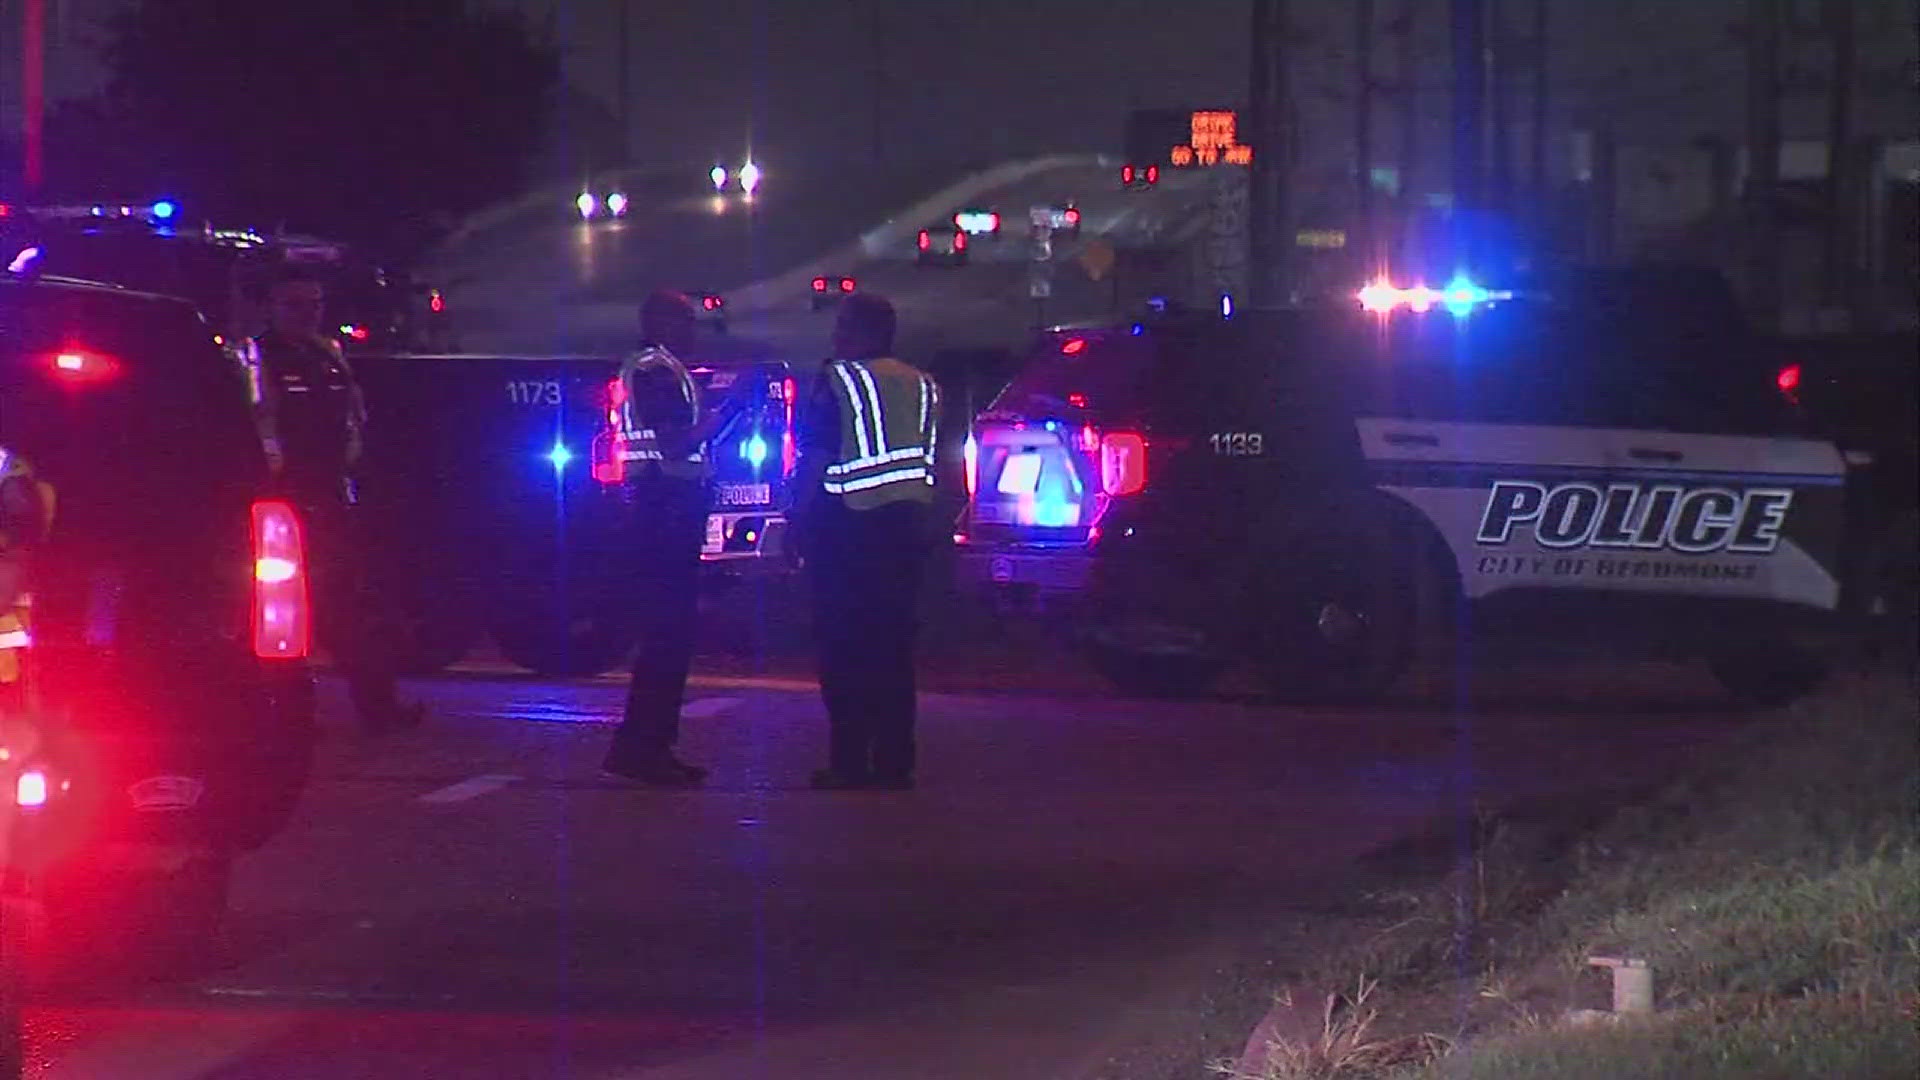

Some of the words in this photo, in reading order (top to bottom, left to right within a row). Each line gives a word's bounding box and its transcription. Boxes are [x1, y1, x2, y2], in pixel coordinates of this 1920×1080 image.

[505, 382, 561, 404] 1173
[1477, 481, 1793, 552] POLICE
[1477, 556, 1546, 575] CITY
[1554, 558, 1587, 576] OF
